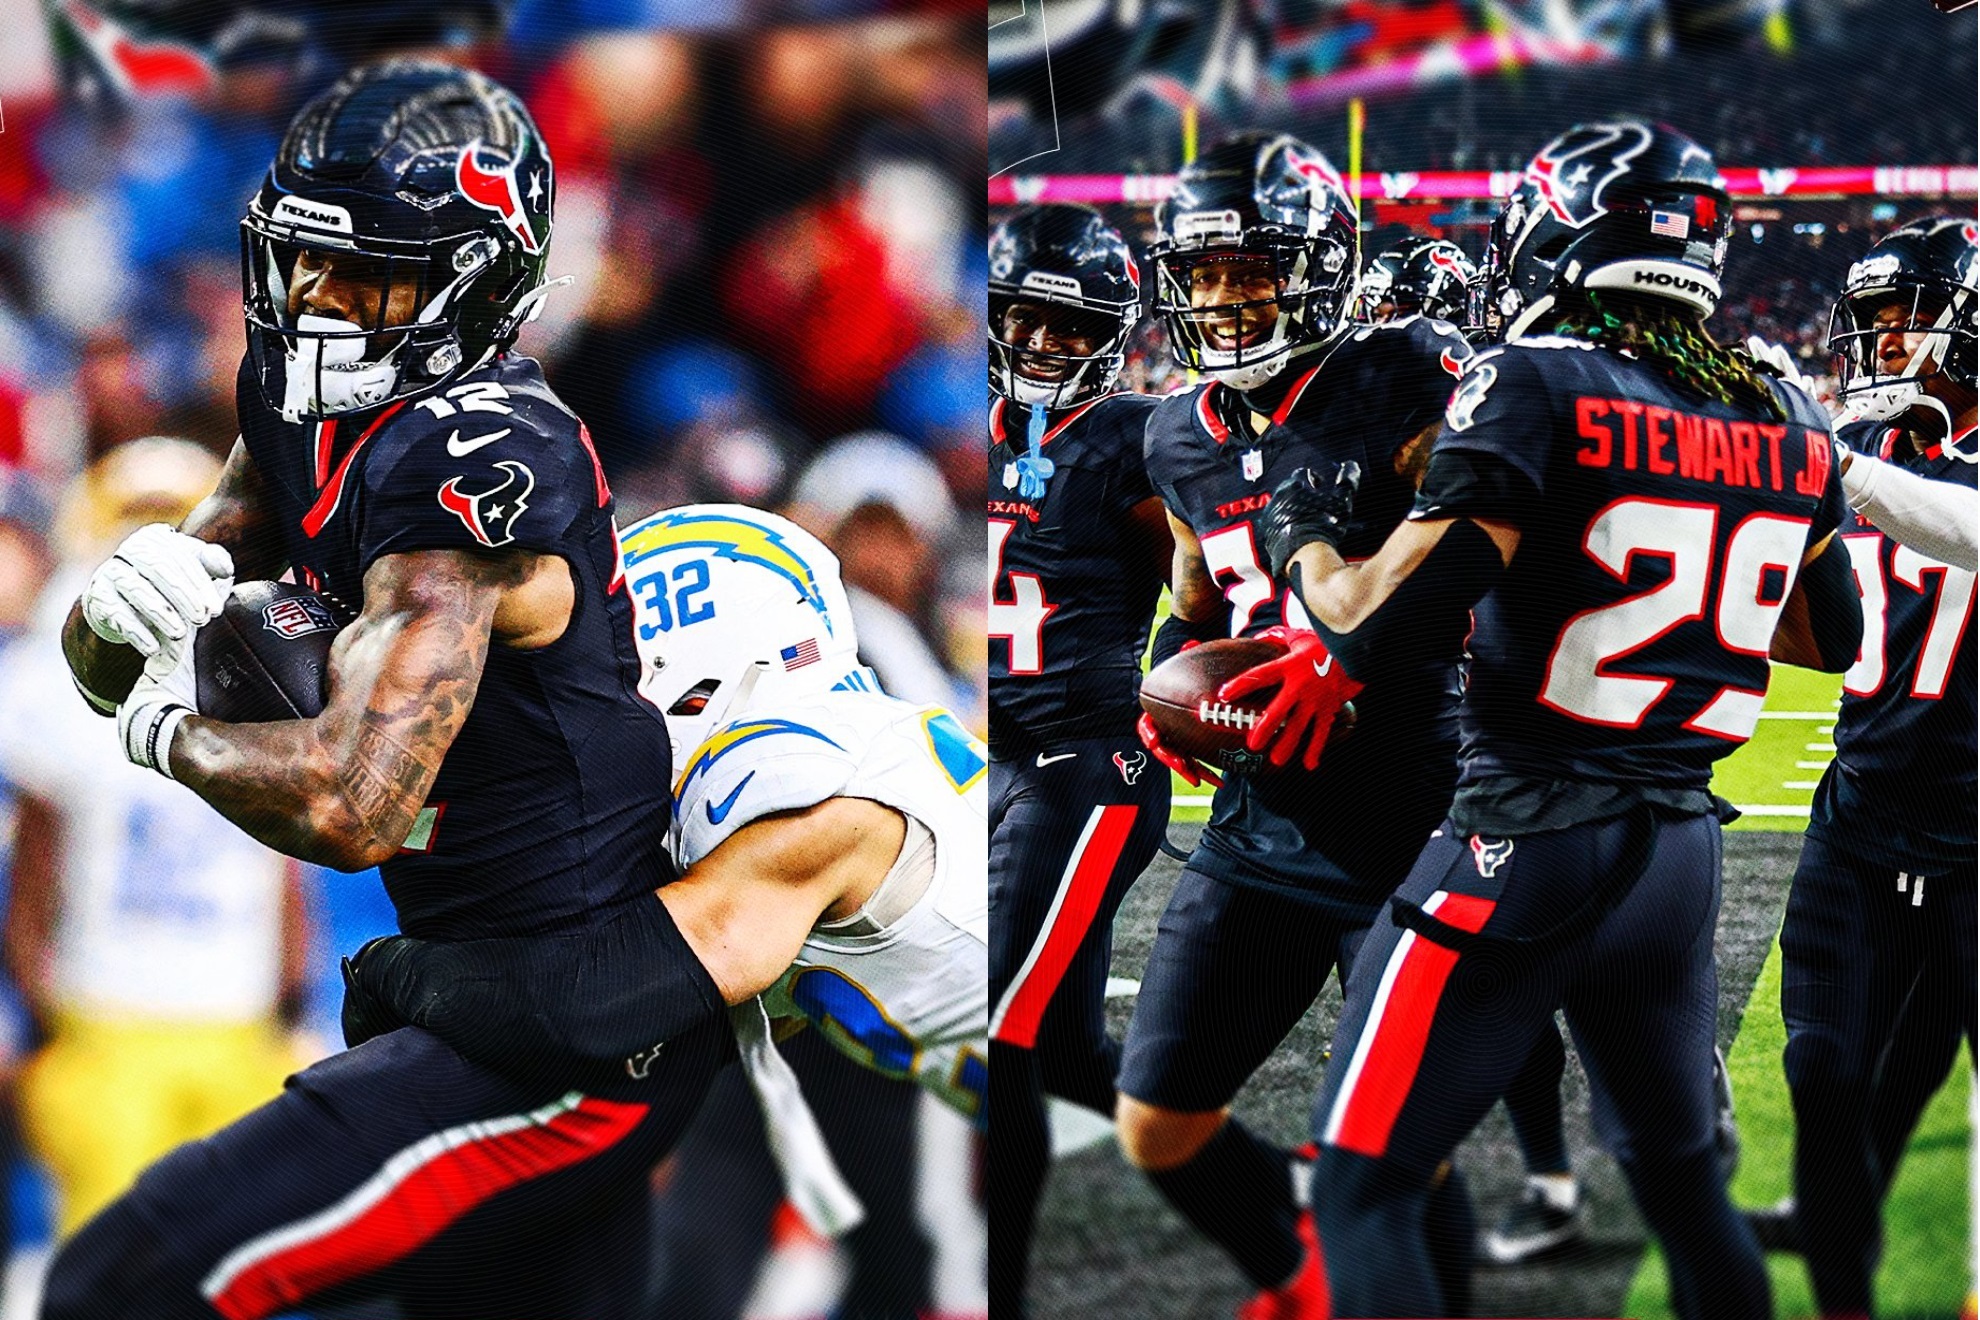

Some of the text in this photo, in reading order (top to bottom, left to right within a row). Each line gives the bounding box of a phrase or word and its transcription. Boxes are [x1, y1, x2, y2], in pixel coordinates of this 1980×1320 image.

[281, 203, 341, 225] TEXANS
[1031, 276, 1076, 288] TEXANS
[413, 382, 514, 419] 12
[1575, 396, 1831, 498] STEWART JR
[271, 601, 311, 634] NFL
[632, 559, 716, 641] 32
[1534, 495, 1812, 742] 29
